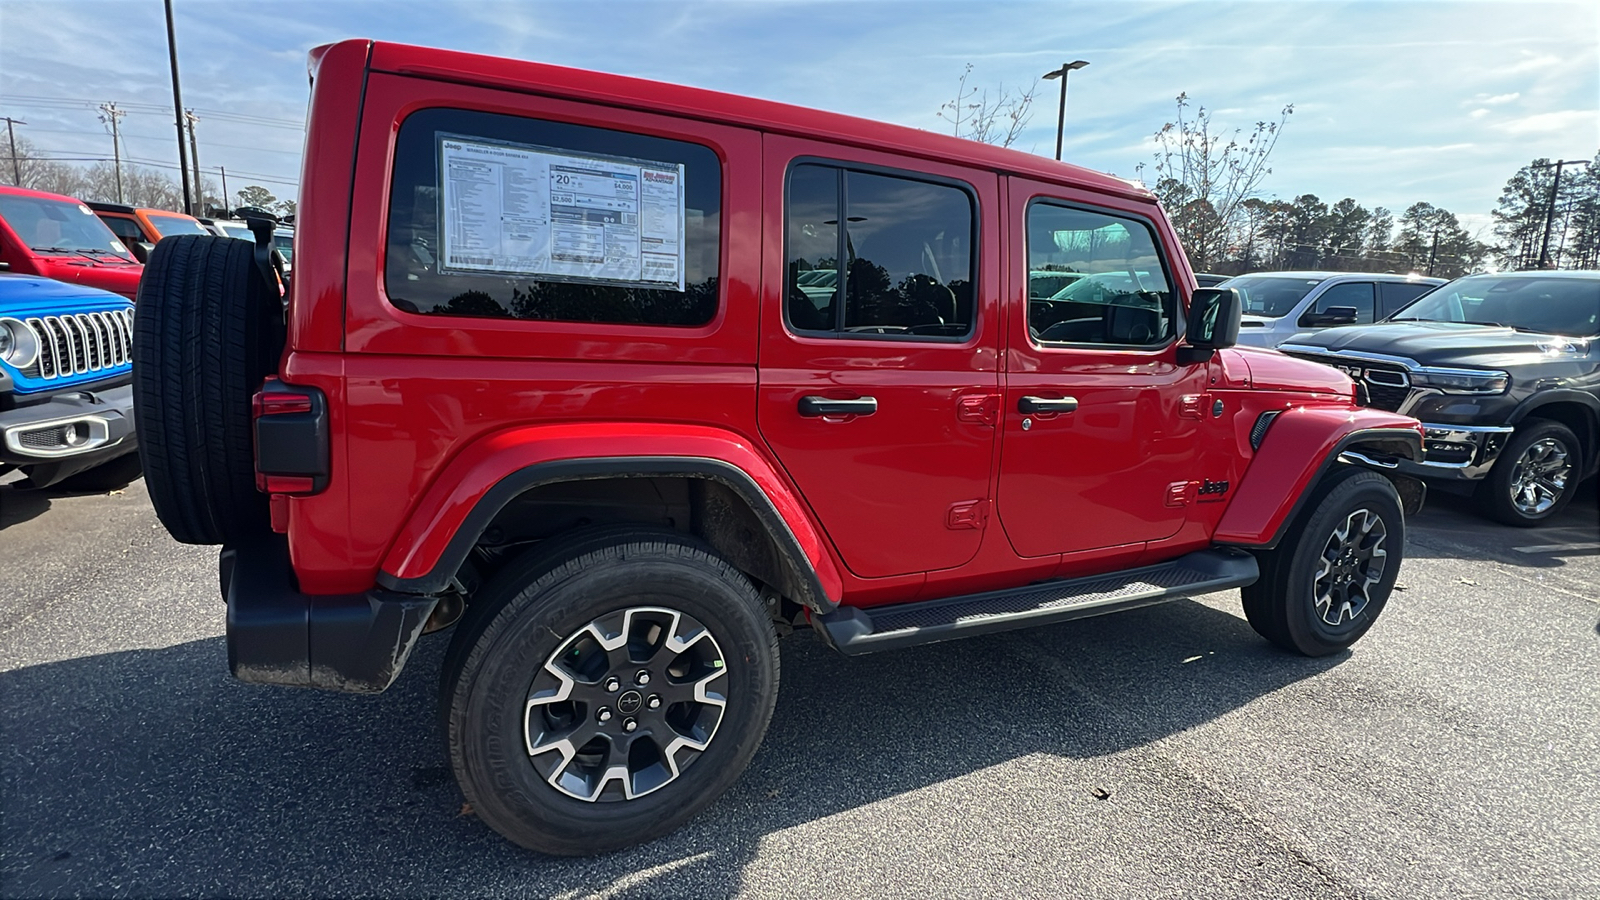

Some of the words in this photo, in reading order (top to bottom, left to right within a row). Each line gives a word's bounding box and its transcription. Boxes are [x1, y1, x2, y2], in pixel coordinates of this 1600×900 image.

[444, 142, 462, 151] Jeep
[556, 174, 570, 185] 20
[1198, 478, 1229, 496] Jeep
